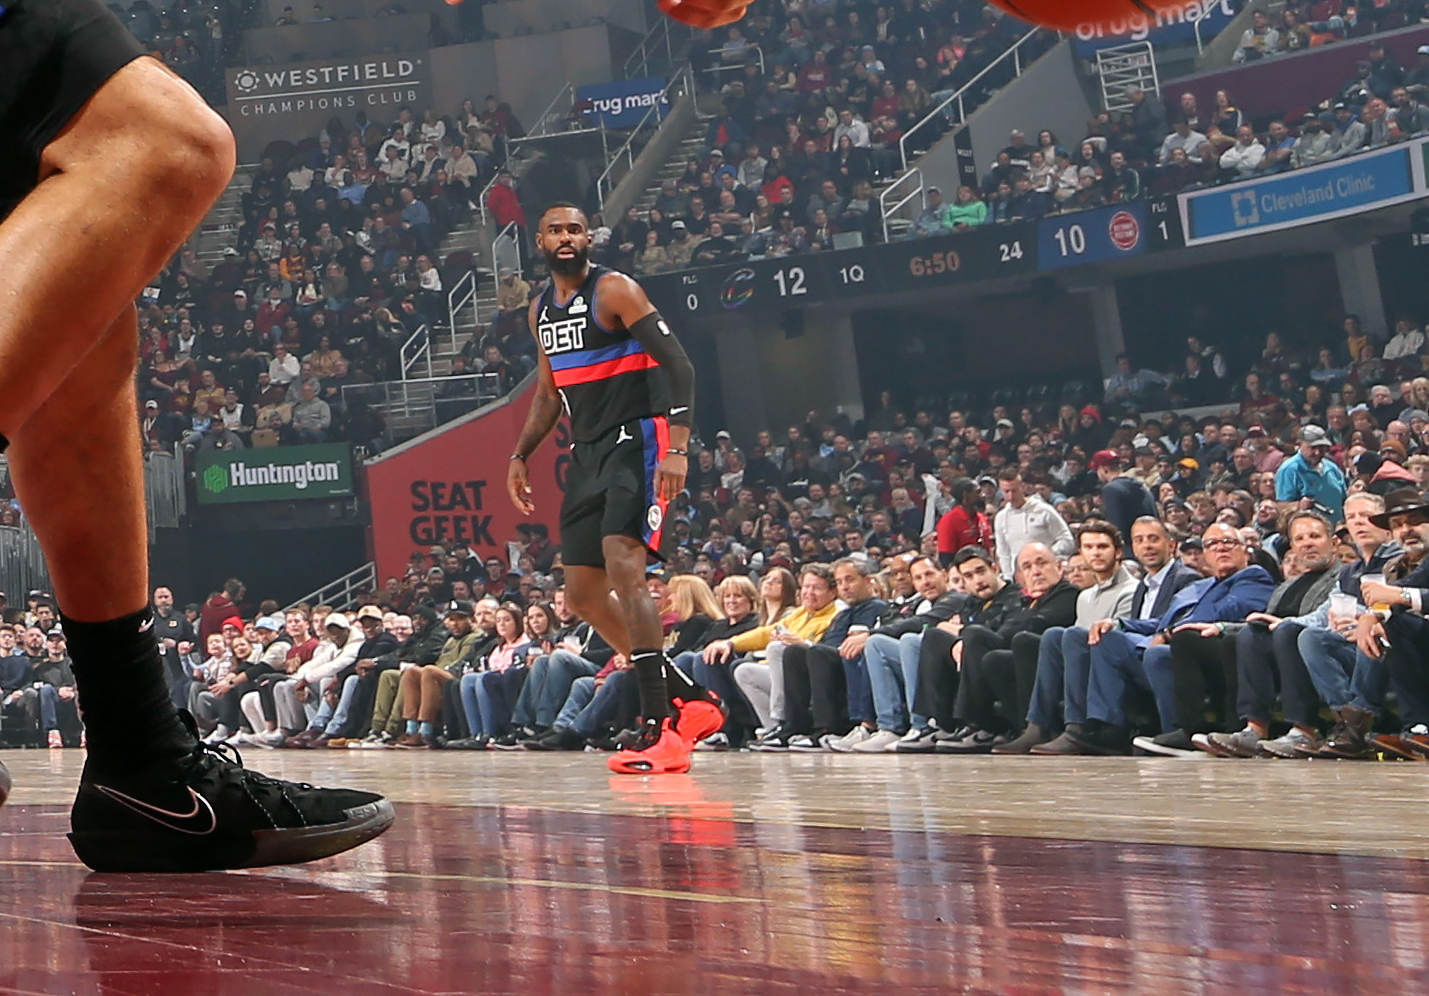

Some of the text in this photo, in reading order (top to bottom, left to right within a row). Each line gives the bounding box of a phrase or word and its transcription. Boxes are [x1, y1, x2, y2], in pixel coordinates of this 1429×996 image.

[264, 60, 415, 88] WESTFIELD
[240, 90, 417, 117] CHAMPIONS CLUB
[1261, 173, 1376, 213] Cleveland Clinic
[687, 293, 698, 310] 0
[773, 266, 807, 296] 12
[839, 264, 865, 284] 1Q
[909, 250, 962, 278] 6:50
[999, 241, 1023, 262] 24
[1054, 223, 1086, 257] 10
[1158, 220, 1169, 241] 1
[538, 316, 587, 355] DET
[229, 460, 339, 490] Huntington
[410, 479, 487, 513] SEAT
[409, 515, 497, 547] GEEK
